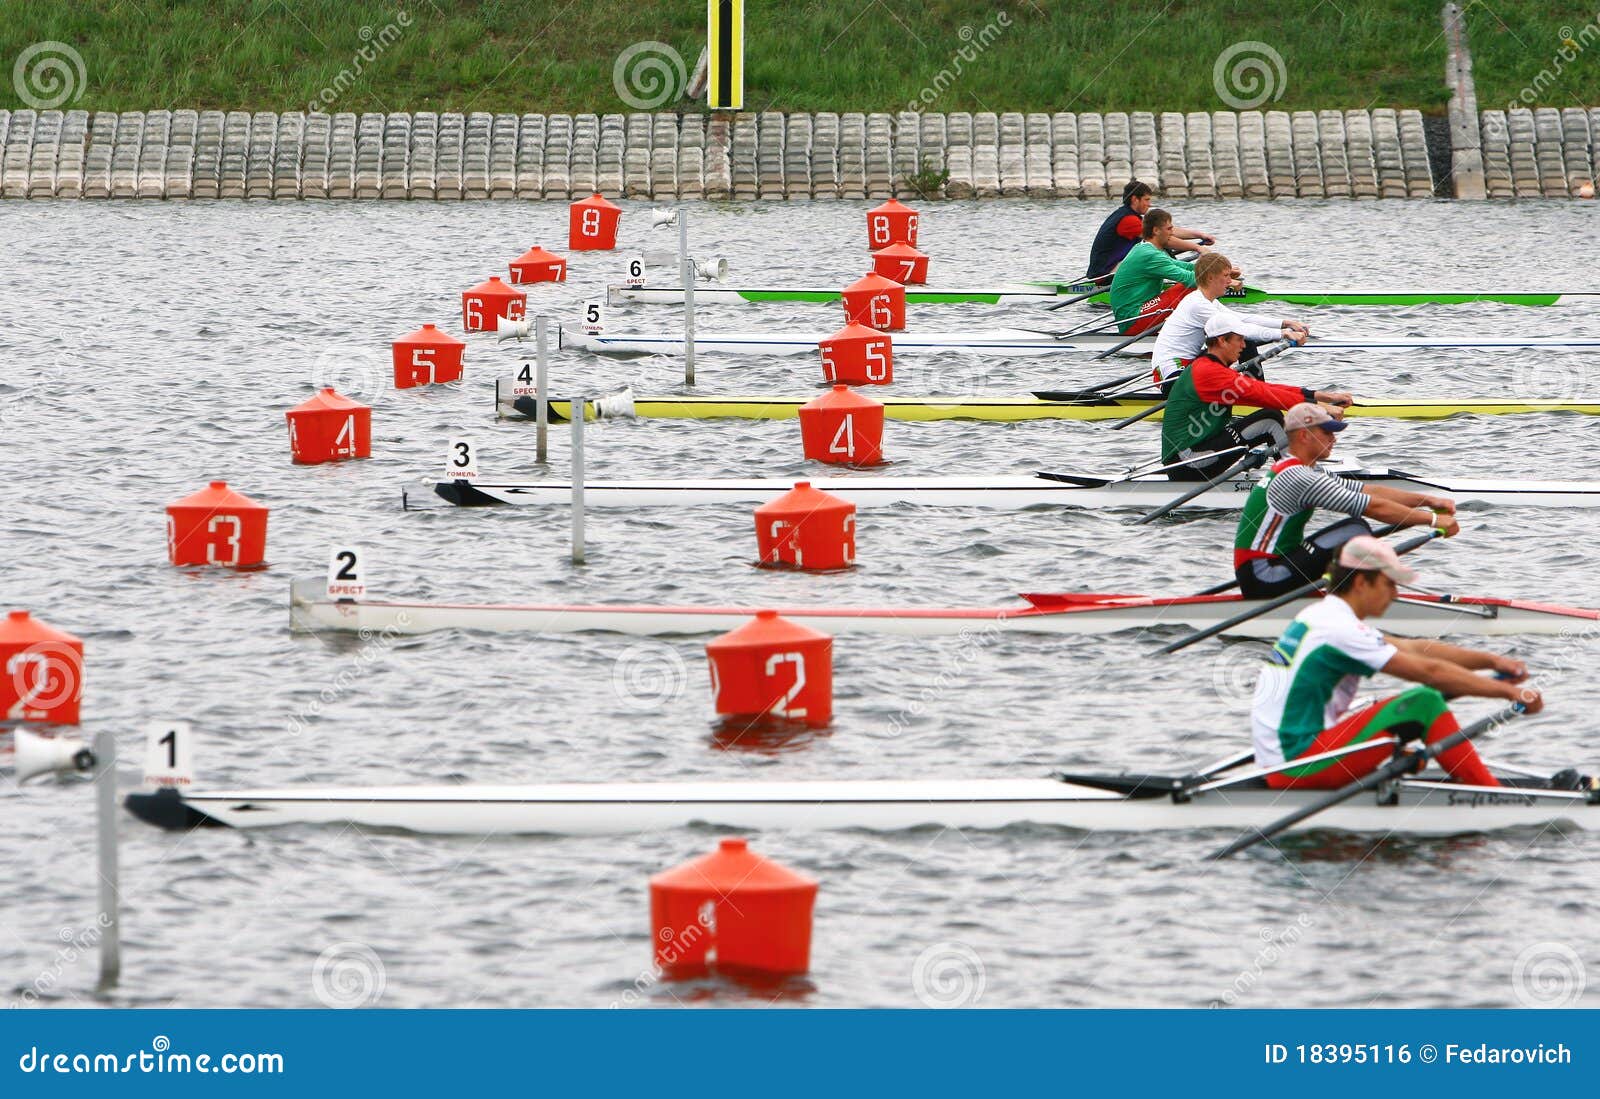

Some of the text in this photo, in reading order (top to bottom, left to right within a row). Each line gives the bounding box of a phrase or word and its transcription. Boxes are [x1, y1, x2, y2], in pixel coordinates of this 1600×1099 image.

[582, 208, 601, 237] 8
[873, 216, 890, 243] 8
[511, 265, 563, 284] 7 7
[629, 260, 642, 278] 6
[899, 260, 916, 281] 7
[466, 298, 484, 332] 6
[586, 304, 600, 323] 5
[870, 295, 892, 329] 6
[411, 349, 436, 387] 5
[517, 364, 533, 386] 4
[866, 342, 886, 381] 5
[829, 413, 856, 458] 4
[453, 442, 470, 468] 3
[206, 514, 242, 567] 3
[335, 551, 358, 580] 2
[6, 652, 49, 719] 2
[765, 652, 808, 718] 2
[158, 730, 176, 768] 1
